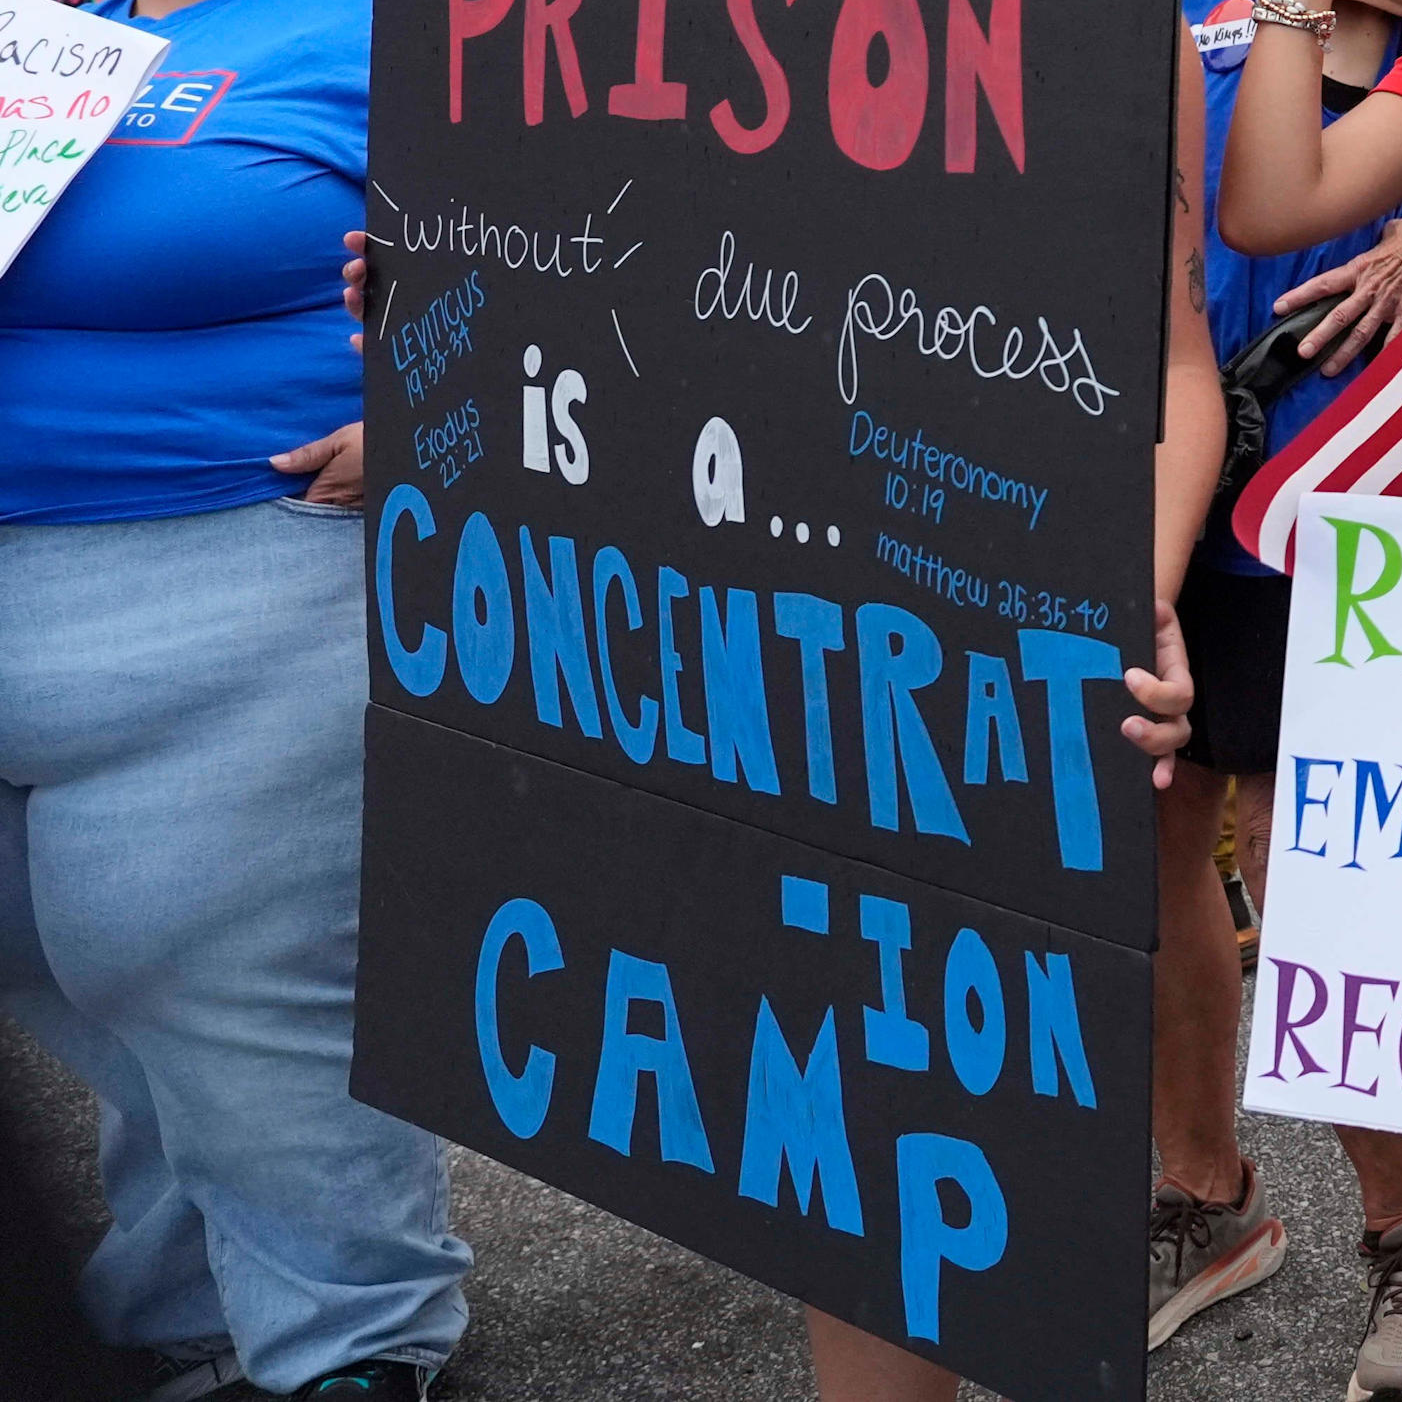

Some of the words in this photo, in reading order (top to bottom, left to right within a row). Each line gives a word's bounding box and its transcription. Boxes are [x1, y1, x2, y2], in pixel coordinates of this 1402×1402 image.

[0, 95, 54, 120] as
[66, 89, 111, 120] no
[391, 269, 485, 372] LEVITICUS
[403, 197, 604, 278] without
[694, 230, 813, 336] due
[838, 274, 1120, 416] process
[413, 398, 481, 470] Exodus
[522, 344, 590, 486] is
[849, 410, 1049, 531] Deuteronomy
[885, 471, 946, 524] 10:19
[876, 531, 990, 607] matthew
[375, 483, 1123, 872] CONCENTRAT
[474, 896, 1009, 1346] CAMP
